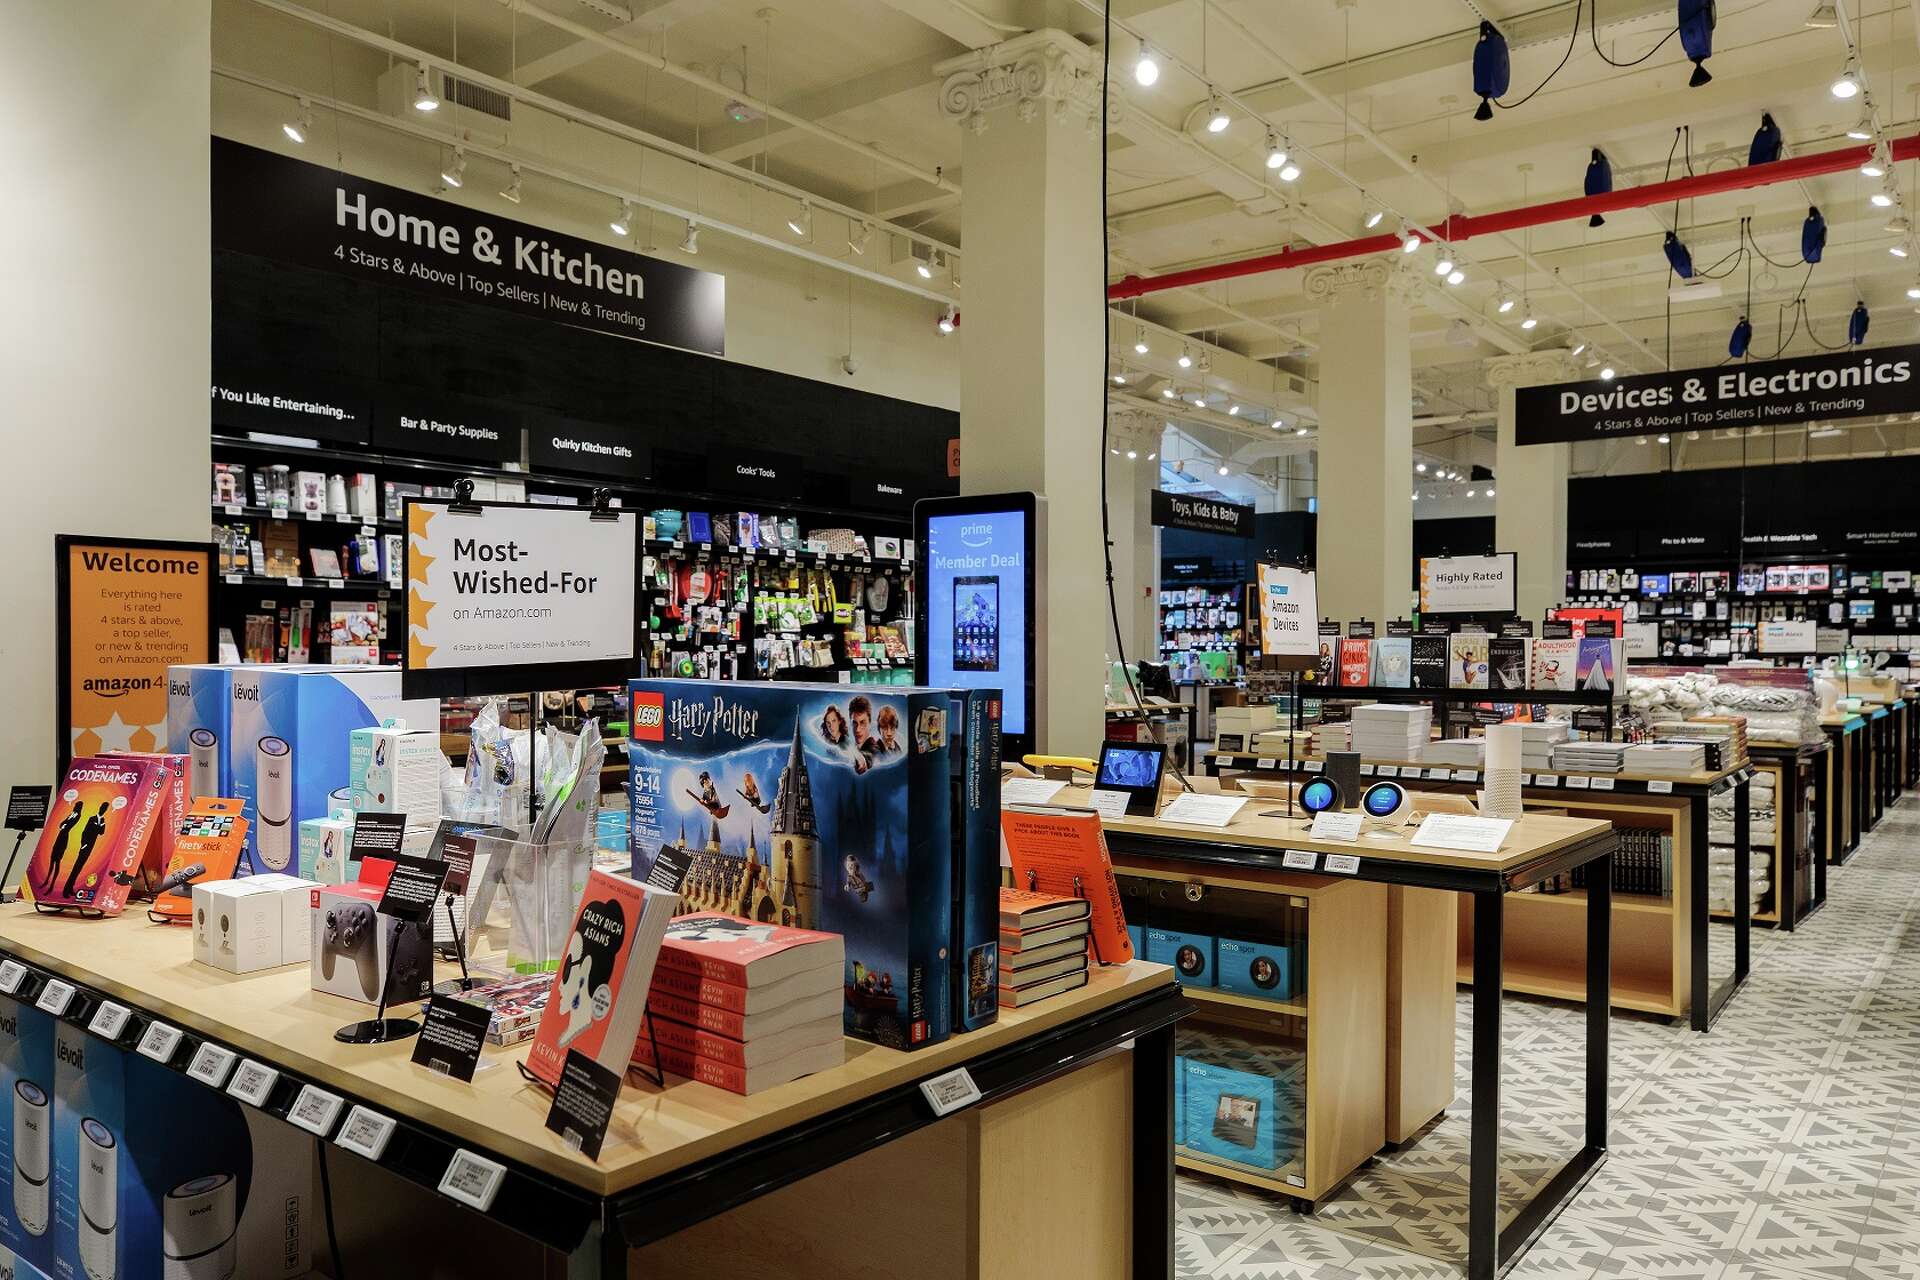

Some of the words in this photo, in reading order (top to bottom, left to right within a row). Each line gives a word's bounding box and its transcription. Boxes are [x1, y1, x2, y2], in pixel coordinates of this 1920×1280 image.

[336, 187, 460, 254] Home
[472, 226, 502, 265] &
[515, 236, 645, 299] Kitchen
[334, 244, 345, 260] 4
[350, 247, 389, 272] Stars
[393, 258, 405, 274] &
[409, 262, 456, 286] Above
[467, 275, 493, 296] Top
[497, 282, 540, 305] Sellers
[550, 295, 578, 314] New
[581, 301, 591, 316] &
[595, 304, 646, 331] Trending
[1560, 386, 1672, 415] Devices
[1682, 379, 1706, 403] &
[1718, 358, 1911, 399] Electronics
[220, 388, 242, 403] You
[246, 391, 270, 408] Like
[273, 396, 355, 420] Entertaining...
[1594, 422, 1602, 431] 4
[1604, 419, 1632, 431] Stars
[1634, 418, 1644, 428] &
[1646, 414, 1682, 427] Above
[1691, 411, 1713, 426] Top
[1715, 406, 1754, 420] Sellers
[1765, 403, 1792, 417] New
[1795, 402, 1805, 414] &
[1809, 396, 1865, 413] Trending
[401, 416, 418, 429] Bar
[419, 419, 428, 430] &
[430, 420, 457, 439] Party
[459, 424, 498, 440] Supplies
[552, 437, 579, 453] Quirky
[581, 441, 611, 456] Kitchen
[613, 444, 632, 458] Gifts
[759, 467, 775, 479] Tools
[877, 484, 903, 495] Bakeware
[1170, 498, 1192, 517] Toys,
[1193, 502, 1210, 518] Kids
[1212, 507, 1218, 519] &
[1220, 508, 1239, 525] Baby
[961, 523, 993, 538] prime
[1770, 534, 1801, 542] Wearable
[1801, 533, 1818, 541] Tech
[1846, 532, 1867, 540] Smart
[1891, 530, 1917, 538] Devices
[1687, 536, 1705, 544] Video
[454, 538, 529, 562] Most-
[82, 551, 200, 575] Welcome
[935, 554, 987, 569] Member
[991, 552, 1020, 567] Deal
[453, 570, 598, 594] Wished-For
[1436, 572, 1470, 584] Highly
[1472, 571, 1503, 581] Rated
[101, 588, 158, 605] Everything
[160, 590, 183, 600] here
[123, 604, 132, 612] is
[134, 603, 161, 612] rated
[1271, 599, 1299, 613] Amazon
[453, 609, 470, 620] on
[473, 607, 552, 619] Amazon.com
[101, 616, 108, 625] 4
[111, 617, 136, 625] stars
[138, 616, 147, 625] &
[150, 616, 183, 626] above,
[1273, 617, 1299, 631] Devices
[122, 629, 140, 641] top
[143, 629, 171, 639] seller,
[109, 643, 130, 651] new
[134, 642, 143, 651] &
[146, 641, 189, 653] trending
[459, 643, 477, 651] Stars
[478, 643, 483, 651] &
[484, 642, 505, 651] Above
[509, 641, 521, 650] Top
[522, 641, 541, 649] Sellers
[546, 640, 559, 648] New
[560, 640, 566, 648] &
[567, 639, 591, 648] Trending
[98, 656, 113, 664] on
[83, 677, 151, 691] amazon
[636, 705, 664, 728] LEGO
[668, 698, 711, 741] Harry
[713, 695, 759, 739] Potter
[69, 769, 138, 785] CODENAMES
[635, 774, 661, 794] 9-14
[123, 790, 159, 868] CODENAMES
[1104, 869, 1112, 884] NOT
[1108, 884, 1118, 909] GIVING
[583, 908, 604, 927] CRAZY
[603, 918, 623, 935] RICH
[583, 926, 610, 947] ASIANS
[1149, 931, 1166, 941] echo
[1221, 943, 1239, 952] echo
[704, 961, 726, 972] KEVIN
[705, 970, 726, 980] KWAN
[911, 967, 922, 994] Potter
[703, 983, 724, 995] KEVIN
[702, 992, 723, 1004] KWAN
[703, 1010, 723, 1021] KEVIN
[703, 1019, 723, 1030] KWAN
[703, 1039, 724, 1050] KEVIN
[536, 1042, 557, 1062] KEVIN
[704, 1048, 725, 1060] KWAN
[703, 1063, 724, 1075] KEVIN
[1189, 1066, 1207, 1077] echo
[703, 1072, 724, 1084] KWAN
